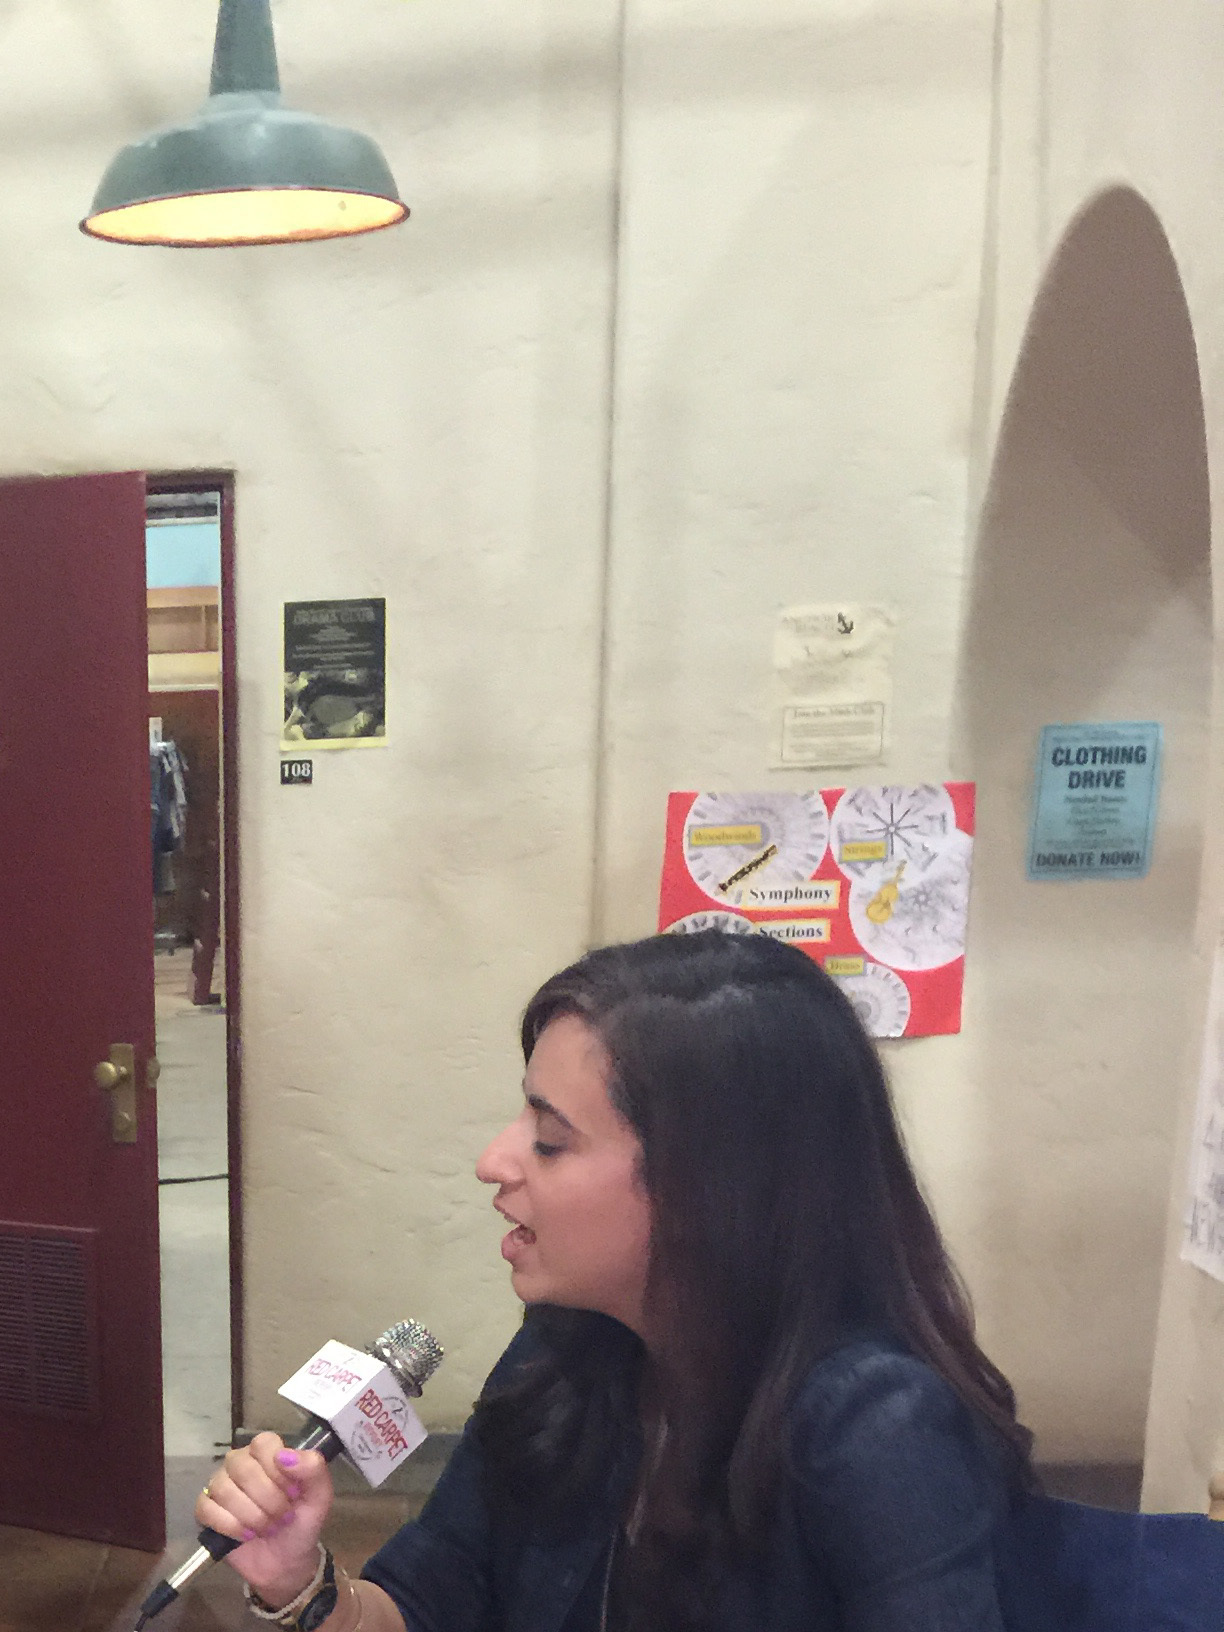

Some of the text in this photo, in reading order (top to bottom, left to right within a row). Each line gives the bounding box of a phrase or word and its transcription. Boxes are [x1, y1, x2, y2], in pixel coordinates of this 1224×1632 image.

[1051, 745, 1147, 766] CLOTHING
[282, 763, 311, 778] 108
[1067, 769, 1126, 789] DRIVE
[1036, 850, 1141, 867] DONATE NOW!
[750, 886, 833, 904] Symphony
[759, 925, 823, 940] Sections
[354, 1388, 383, 1420] RED
[373, 1410, 409, 1461] CARPET
